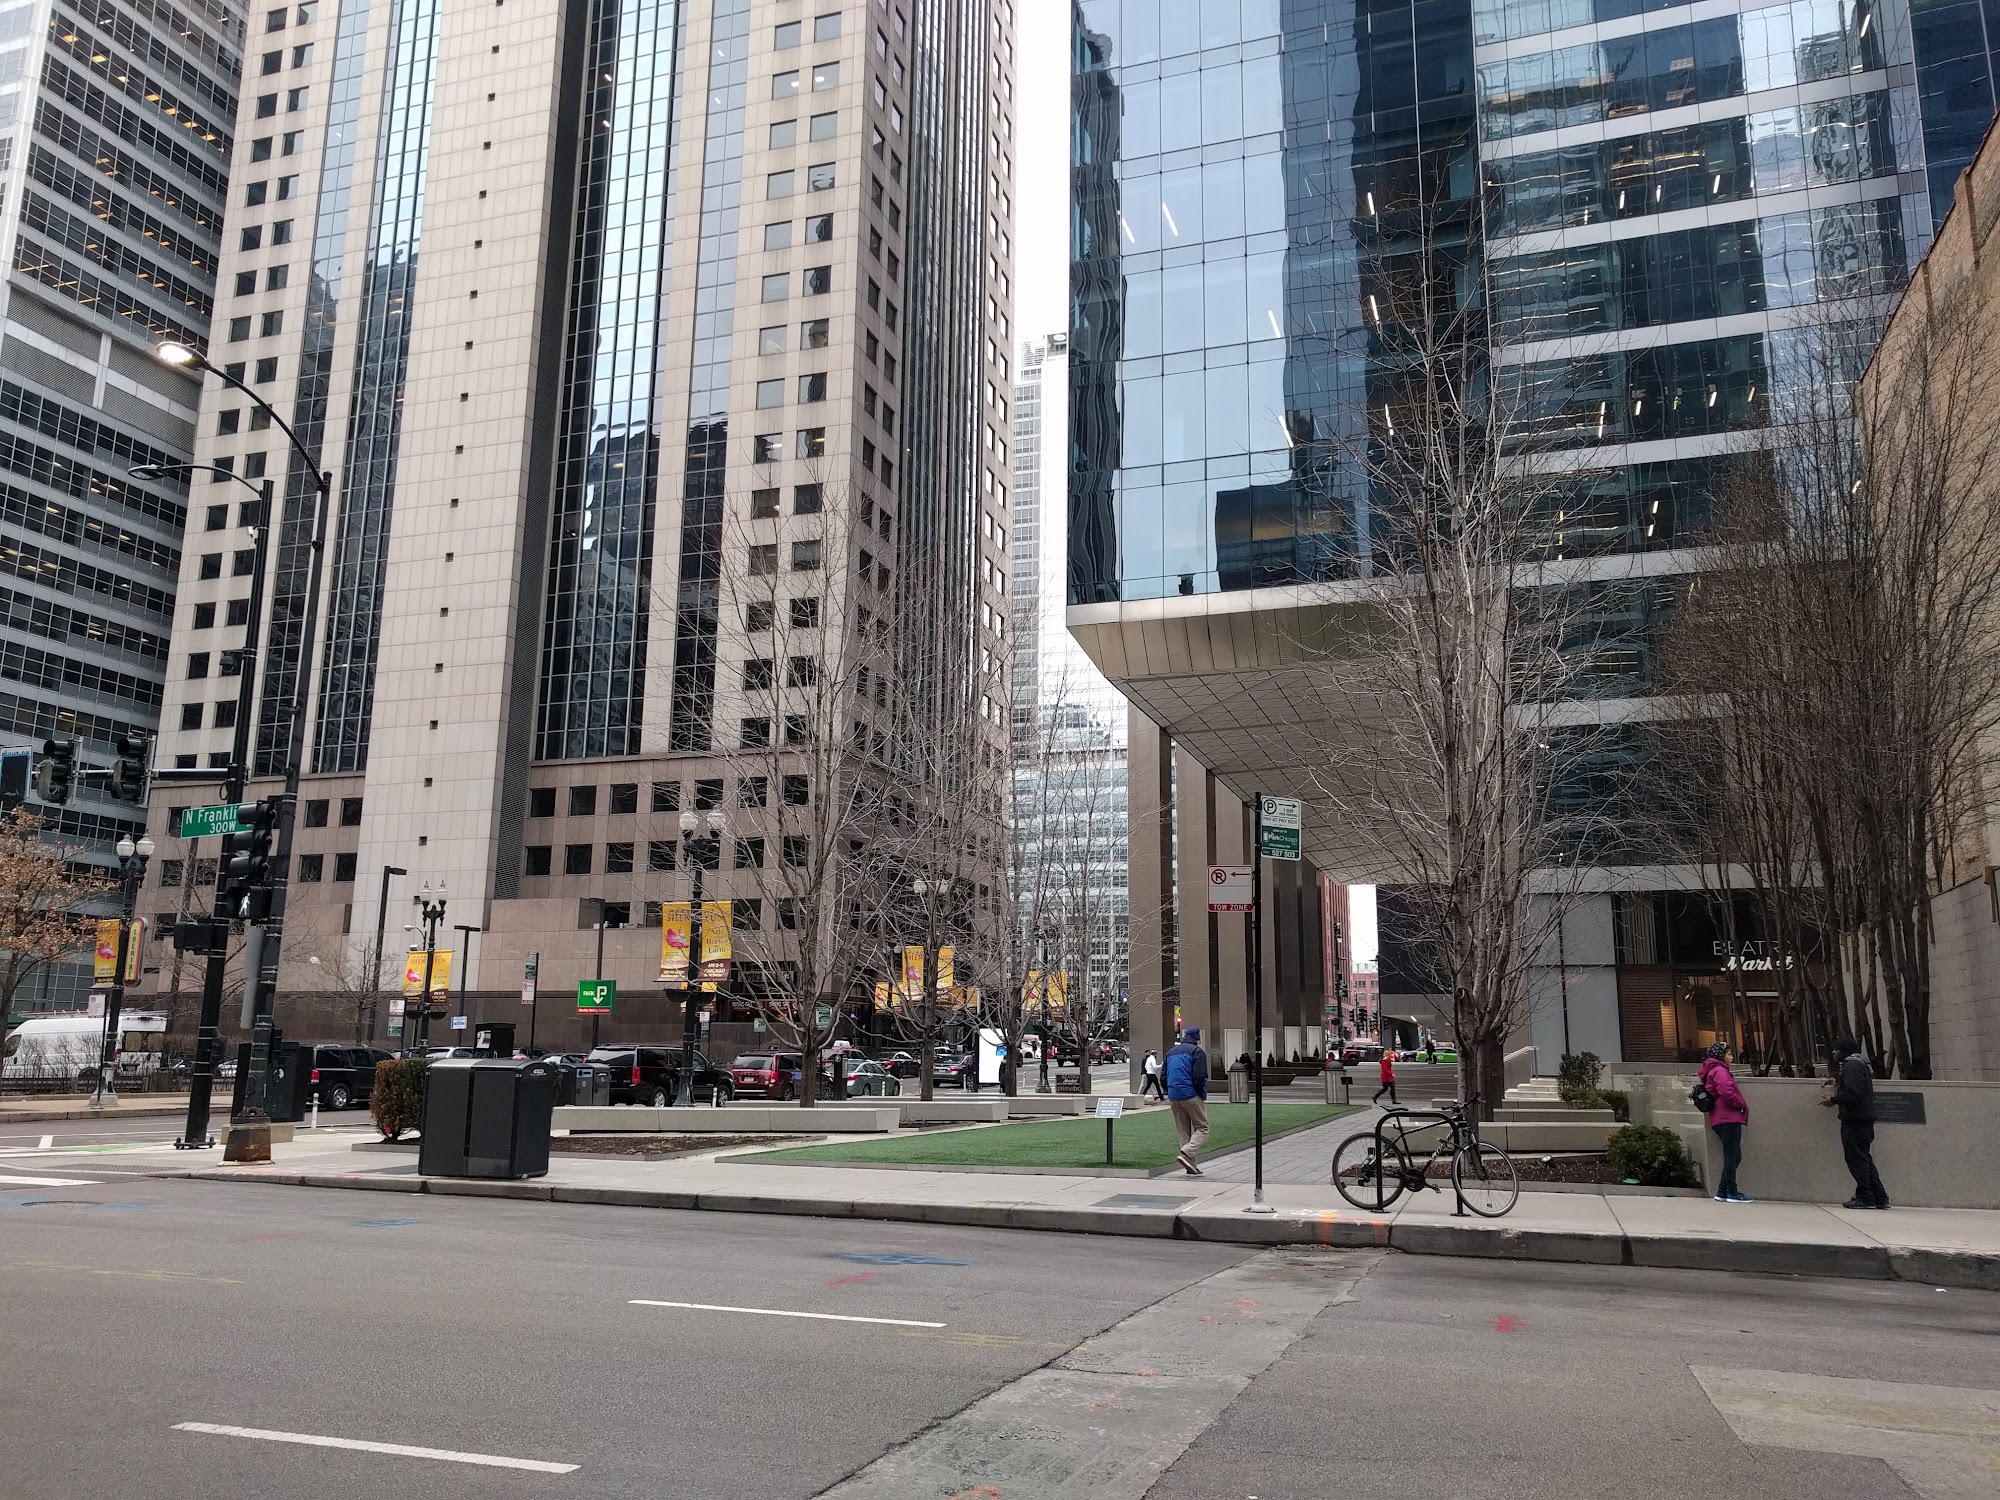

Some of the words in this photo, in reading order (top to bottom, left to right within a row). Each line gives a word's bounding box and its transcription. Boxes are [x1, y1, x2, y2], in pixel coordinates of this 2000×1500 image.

[186, 810, 194, 824] N
[198, 806, 237, 823] Frankli
[209, 820, 236, 833] 300W
[128, 929, 138, 977] THEATRE
